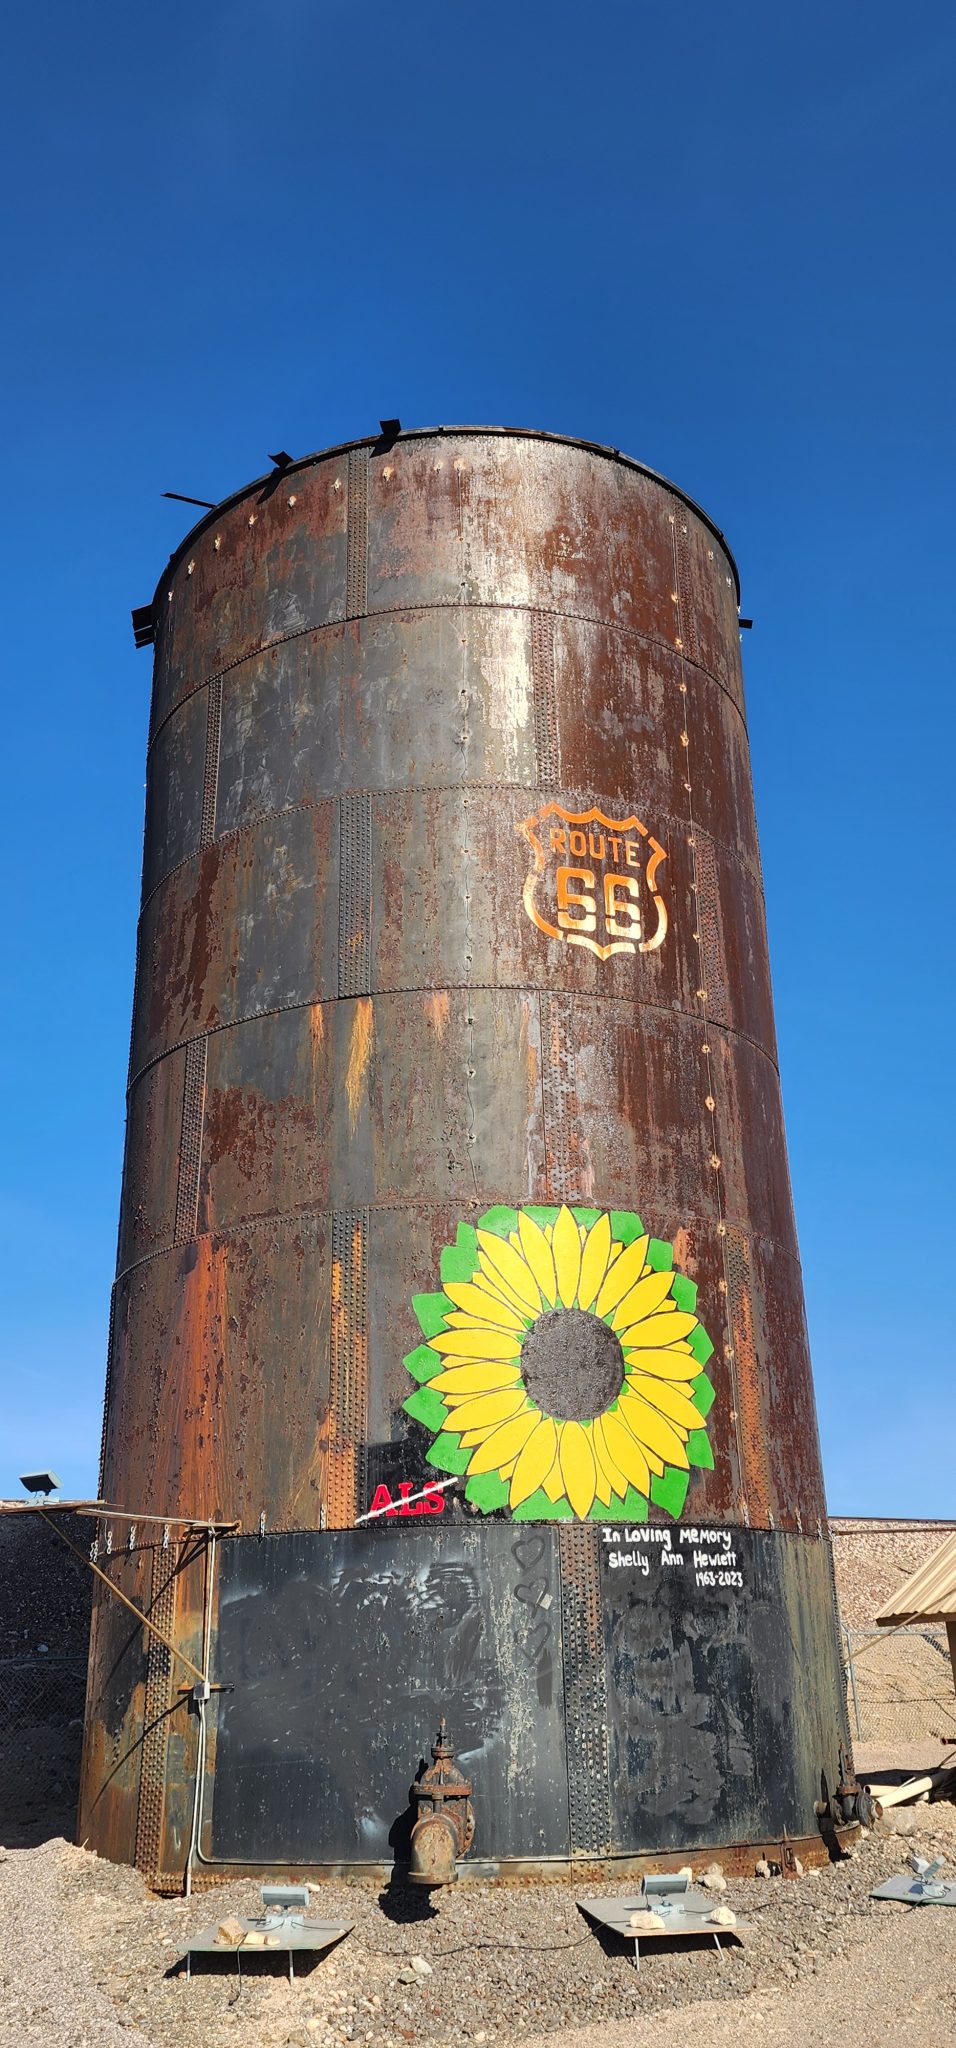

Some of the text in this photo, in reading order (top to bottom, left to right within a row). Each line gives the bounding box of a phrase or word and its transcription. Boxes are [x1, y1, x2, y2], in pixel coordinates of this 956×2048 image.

[549, 827, 641, 868] ROUTE
[556, 866, 642, 940] 66
[369, 1480, 446, 1518] ALS
[602, 1527, 621, 1543] In
[608, 1550, 737, 1576] Shelly Ann Hewlett
[695, 1571, 744, 1588] 1963-2023
